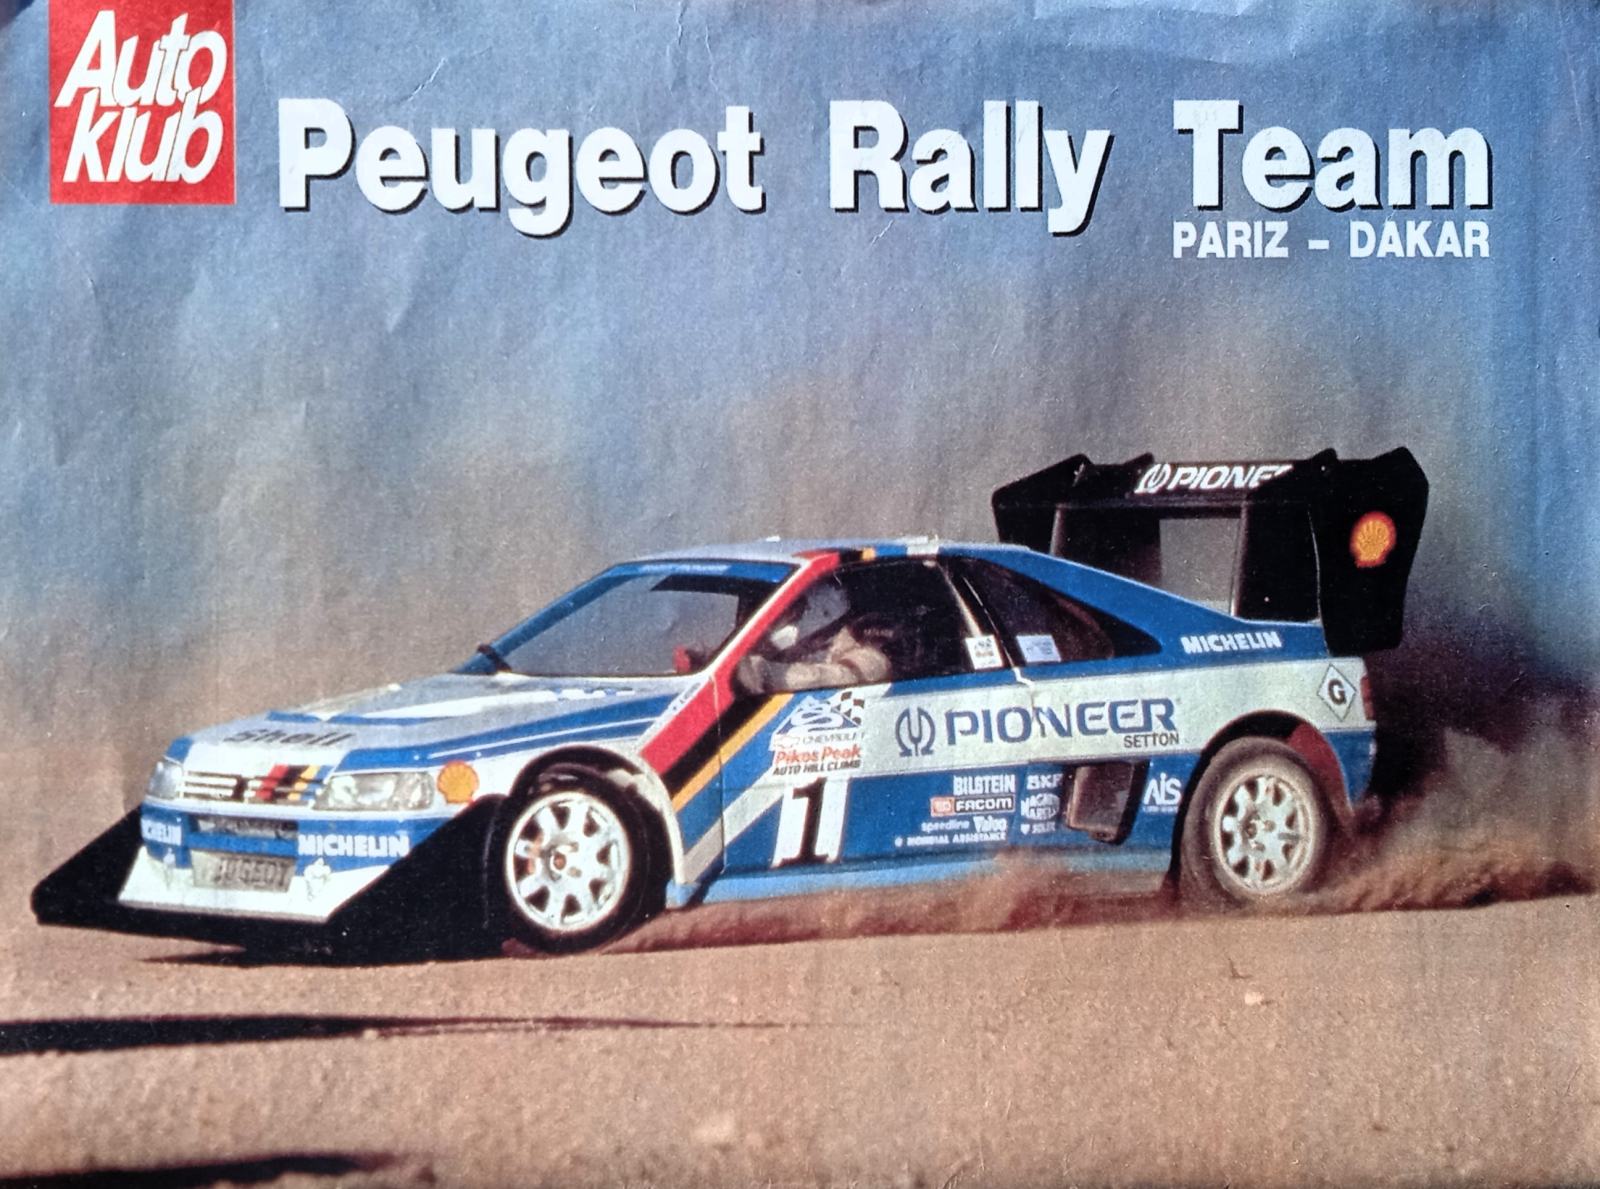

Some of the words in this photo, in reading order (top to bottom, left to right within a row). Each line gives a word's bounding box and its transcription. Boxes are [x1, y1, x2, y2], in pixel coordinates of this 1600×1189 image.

[54, 9, 227, 107] Auto
[63, 87, 223, 185] klub
[278, 98, 766, 238] Peugeot
[829, 99, 1111, 237] Rally
[1173, 99, 1494, 212] Team
[1172, 220, 1289, 259] PARIZ
[1348, 220, 1491, 259] DAKAR
[1166, 464, 1293, 491] PIONE
[1180, 631, 1283, 655] MICHELIN
[1328, 678, 1347, 705] G
[944, 698, 1177, 746] PIONEER
[222, 729, 353, 747] Shell
[1123, 733, 1180, 749] SETTON
[775, 749, 819, 764] Pikes
[821, 744, 862, 762] Peak
[772, 765, 801, 776] AUTO
[803, 762, 825, 773] HILL
[827, 760, 861, 772] CLIMB
[953, 774, 1016, 796] BILSTEIN
[1026, 773, 1063, 790] SKF
[955, 797, 1013, 812] FACOM
[297, 831, 410, 858] MICHELIN
